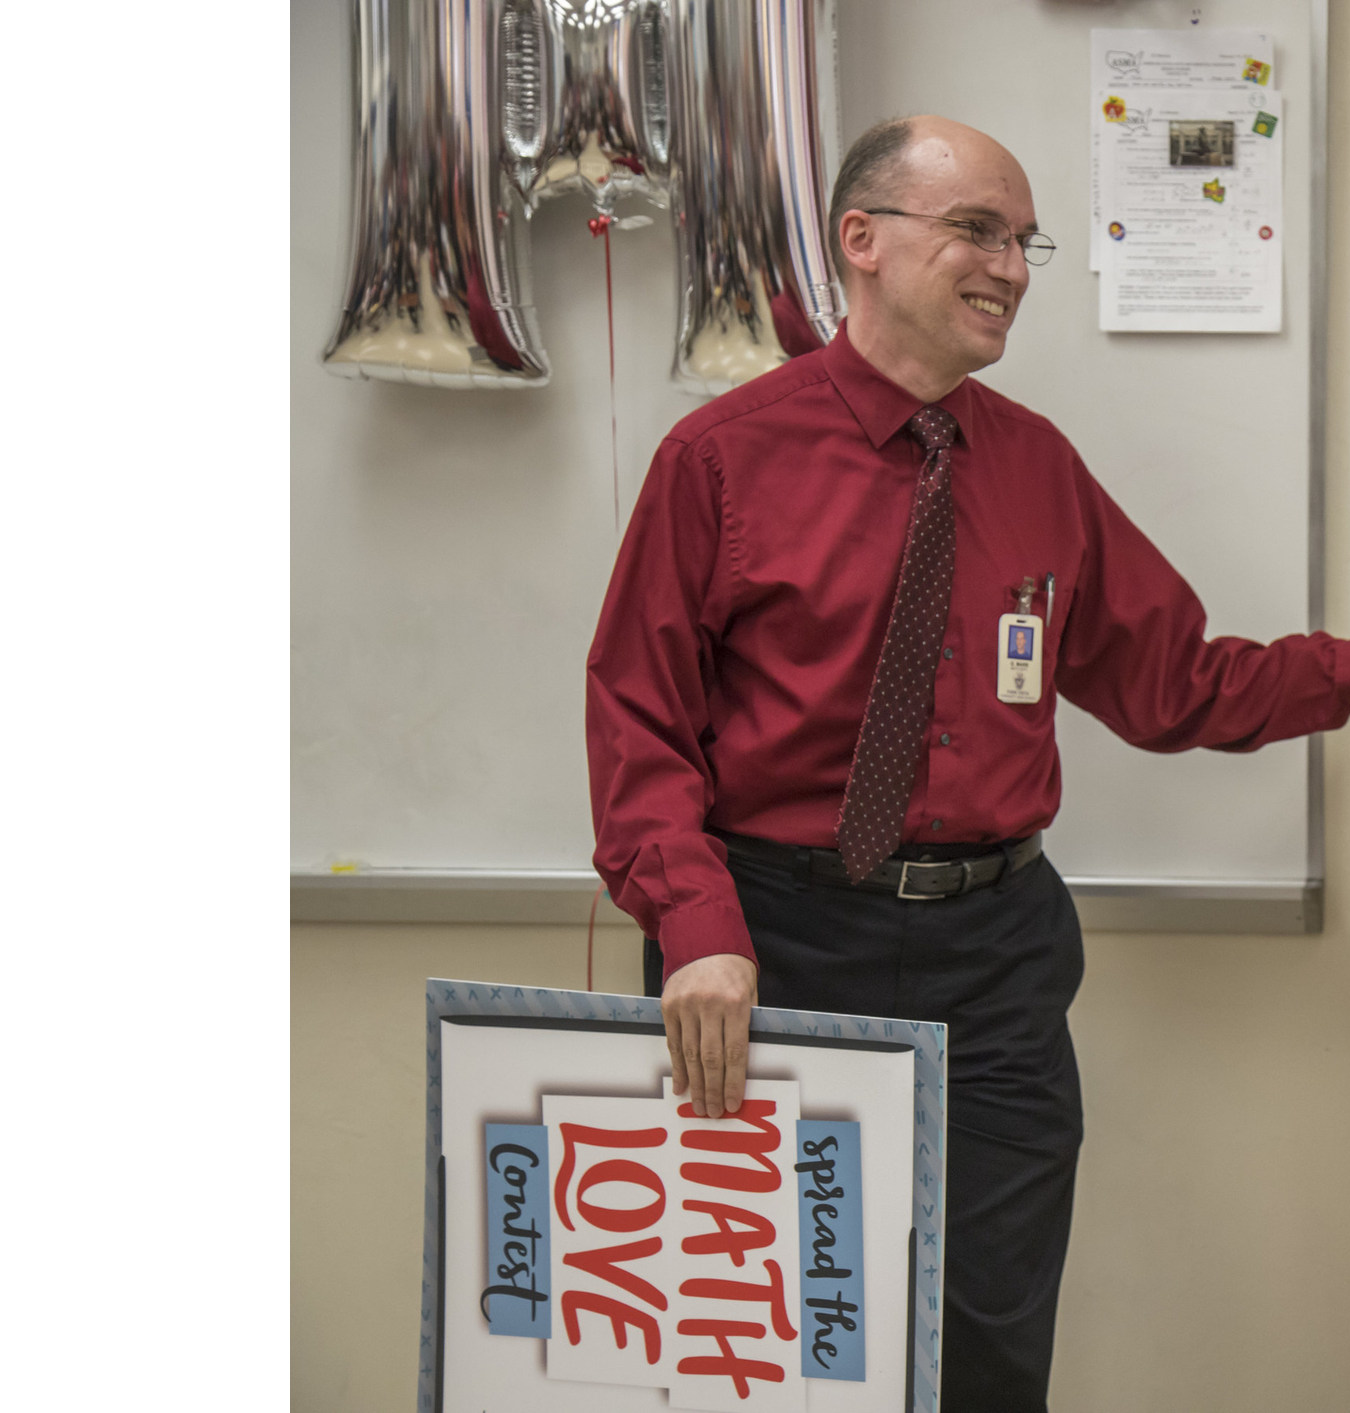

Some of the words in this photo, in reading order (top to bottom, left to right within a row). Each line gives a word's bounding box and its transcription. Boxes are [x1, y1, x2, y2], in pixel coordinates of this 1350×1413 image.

[480, 1143, 548, 1323] Contest
[554, 1122, 668, 1365] LOVE
[677, 1100, 798, 1400] MATH
[794, 1136, 852, 1278] spread
[805, 1290, 858, 1369] the
